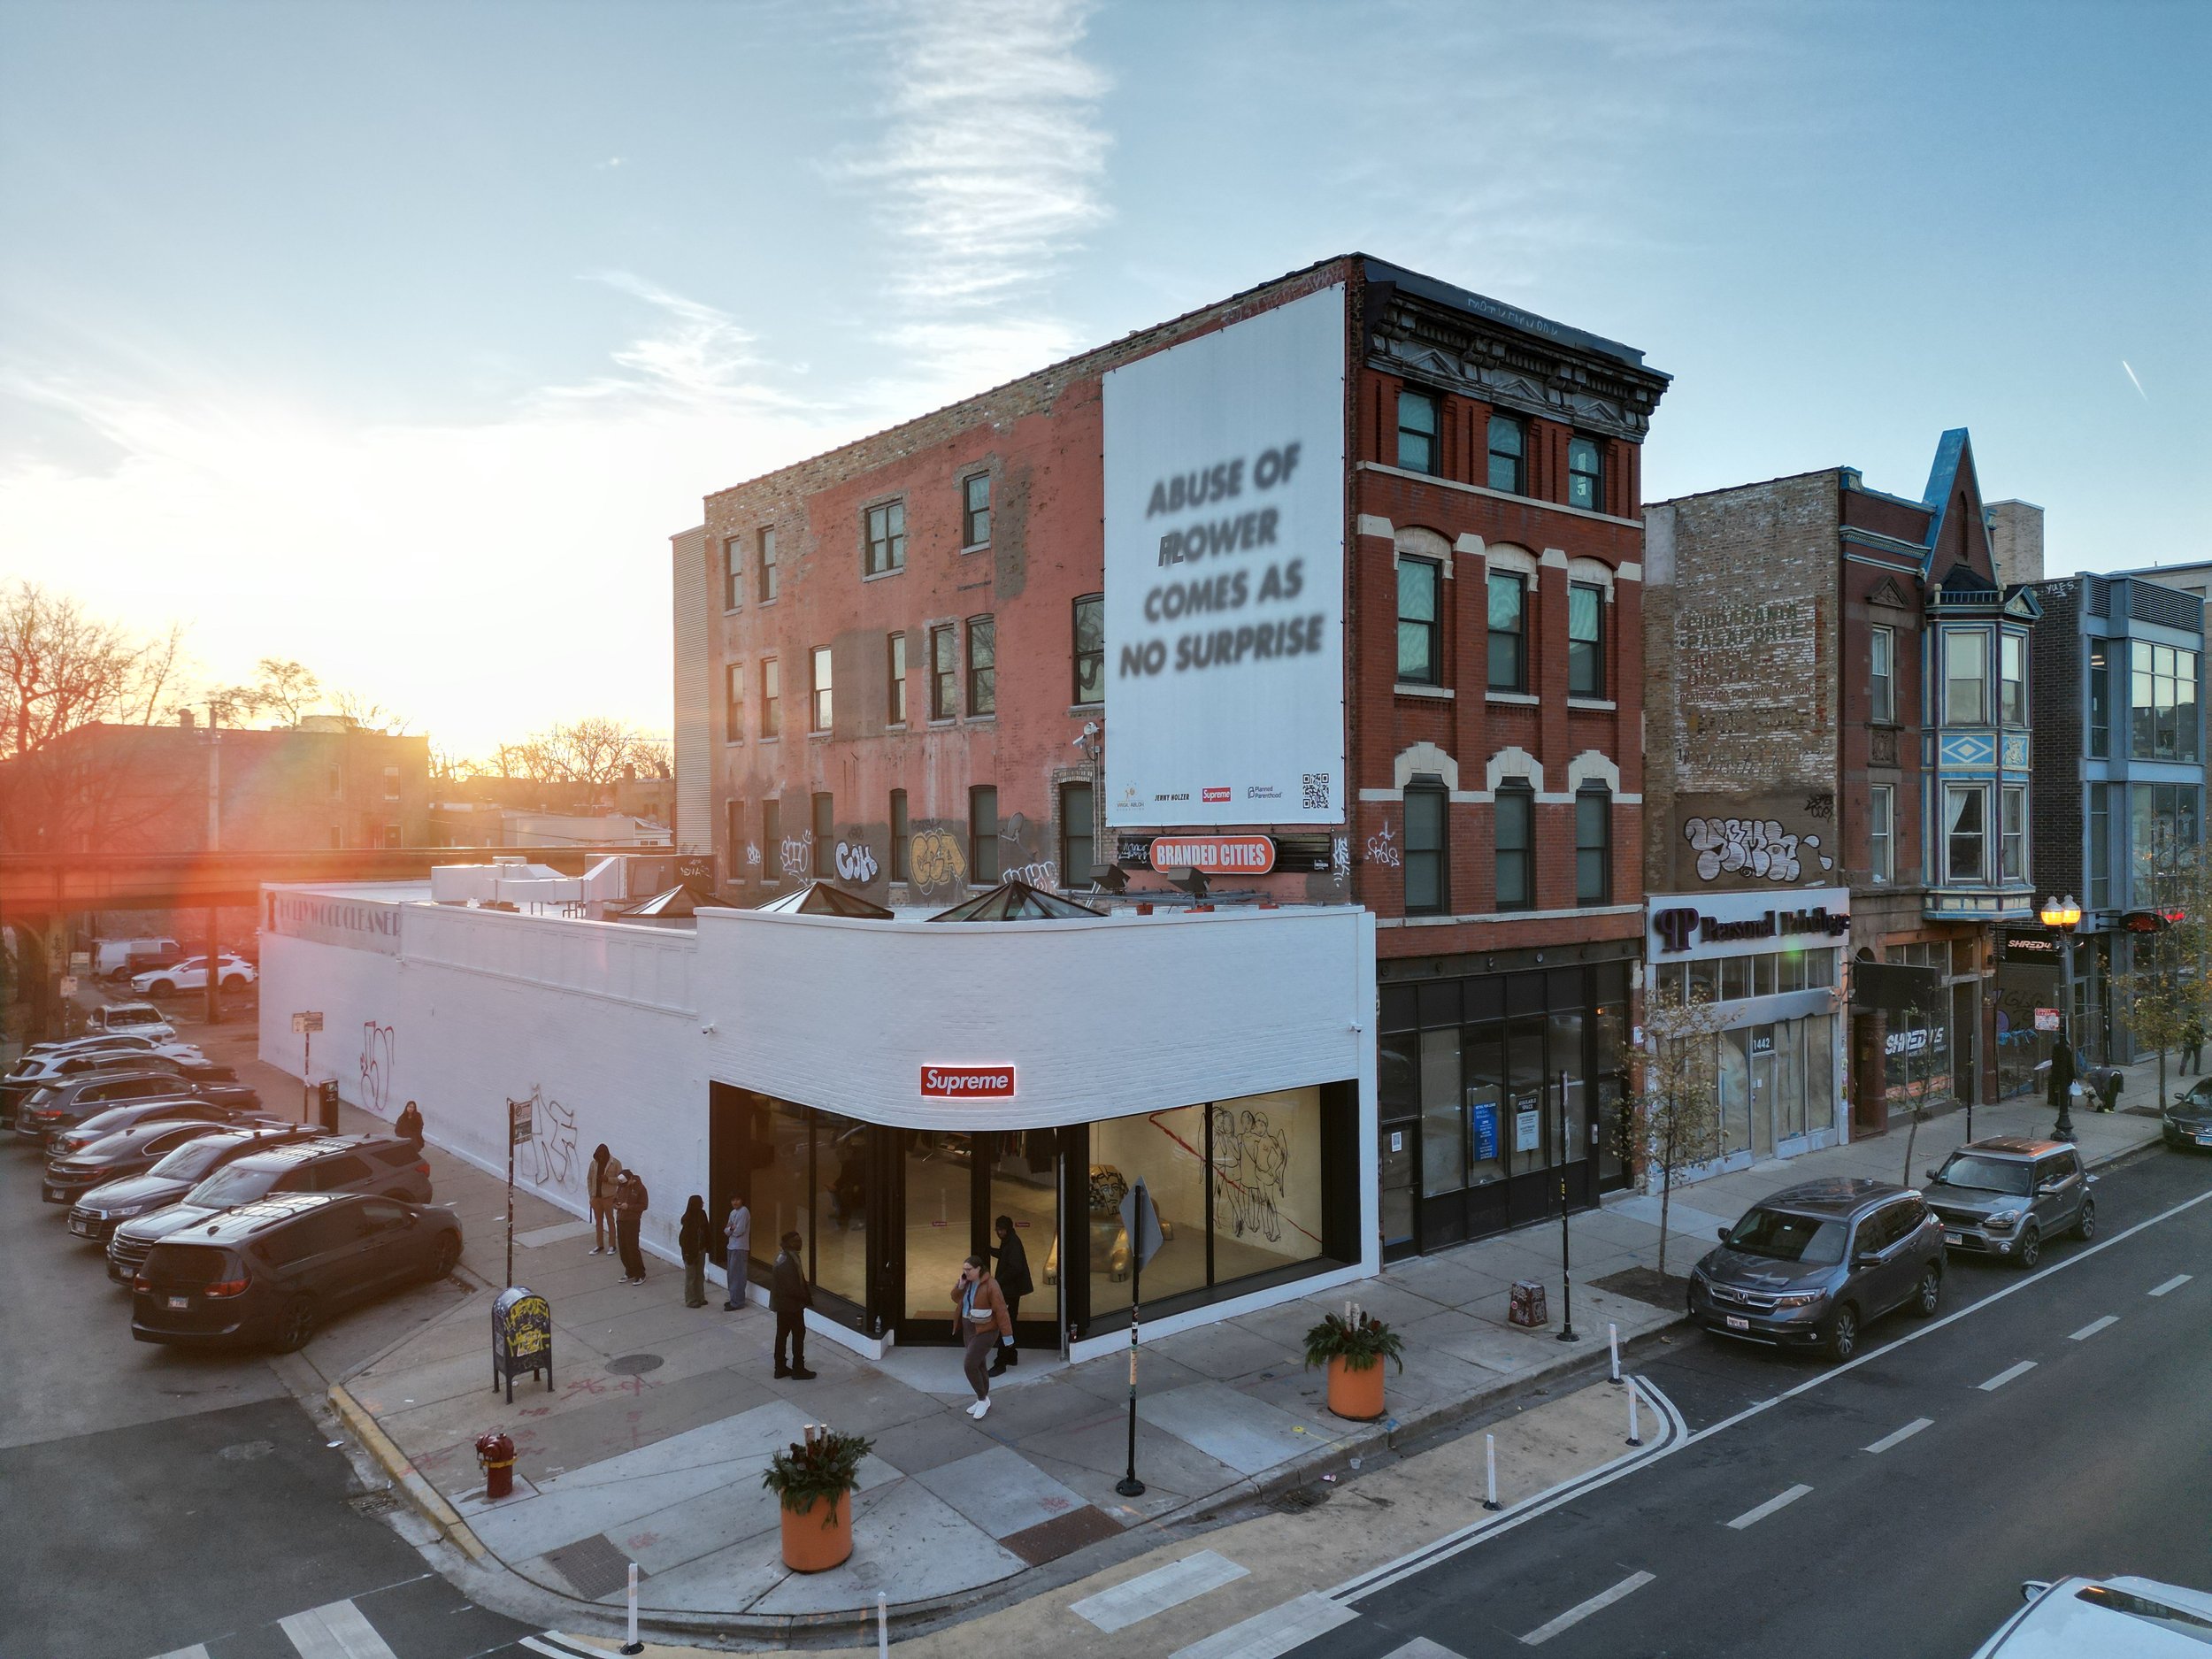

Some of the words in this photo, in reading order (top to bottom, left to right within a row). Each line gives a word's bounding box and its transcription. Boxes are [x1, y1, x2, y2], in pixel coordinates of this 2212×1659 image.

[1147, 457, 1245, 518] ABUSE
[1253, 442, 1302, 490] OF
[1143, 570, 1248, 624] COMES
[1257, 559, 1305, 604] AS
[1119, 638, 1166, 679] NO
[1175, 615, 1325, 673] SURPRISE
[1202, 788, 1230, 802] Supreme
[1156, 844, 1217, 866] BRANDED
[1220, 843, 1265, 865] CITIES
[1701, 910, 1777, 942] Personal
[1753, 1038, 1770, 1050] 1442
[926, 1069, 1009, 1095] Supreme
